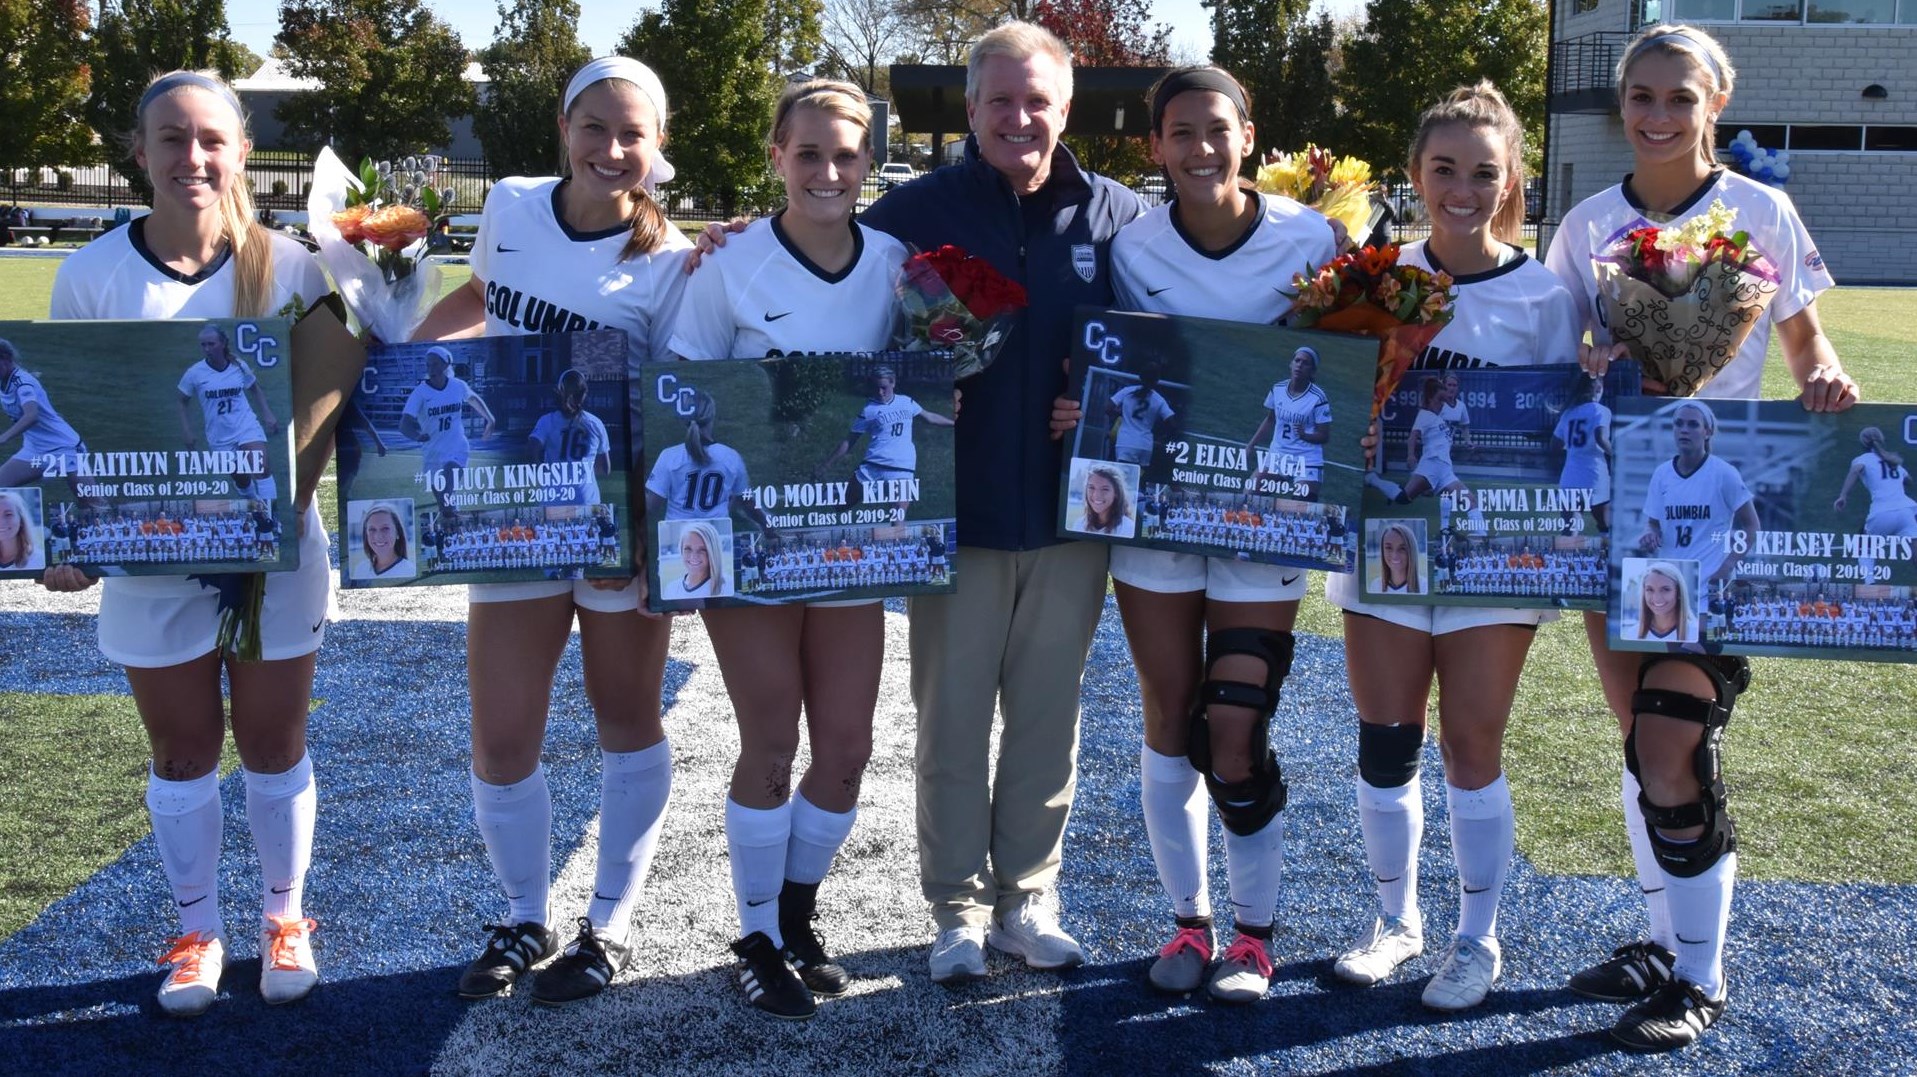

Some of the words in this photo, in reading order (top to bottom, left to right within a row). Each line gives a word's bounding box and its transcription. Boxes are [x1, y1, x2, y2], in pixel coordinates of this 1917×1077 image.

[486, 280, 617, 333] COLUMB
[217, 399, 232, 416] 21
[1132, 400, 1150, 420] 2
[1459, 391, 1497, 408] 1994
[439, 416, 452, 432] 16
[891, 422, 904, 437] 10
[1282, 424, 1292, 439] 2
[1568, 419, 1588, 449] 15
[560, 428, 590, 461] 16
[30, 454, 69, 478] #21
[77, 452, 168, 477] KAITLYN
[175, 450, 265, 475] TAMBKE
[1165, 440, 1190, 465] #2
[1195, 443, 1248, 471] ELISA
[1256, 452, 1307, 478] VEGA
[414, 469, 447, 493] #16
[452, 466, 497, 490] LUCY
[503, 461, 595, 488] KINGSLEY
[1172, 468, 1209, 486] Senior
[1213, 473, 1242, 490] Class
[1245, 476, 1257, 491] of
[1260, 478, 1310, 498] 2019-20
[77, 482, 119, 498] Senior
[123, 482, 155, 497] Class
[159, 481, 171, 496] of
[176, 481, 229, 496] 2019-20
[443, 492, 480, 507] Senior
[483, 491, 511, 505] Class
[514, 490, 525, 504] of
[528, 488, 576, 502] 2019-20
[682, 471, 725, 511] 10
[741, 486, 777, 509] #10
[784, 481, 848, 508] MOLLY
[862, 478, 920, 504] KLEIN
[1440, 489, 1471, 512] #15
[1477, 489, 1529, 512] EMMA
[1535, 488, 1594, 512] LANEY
[765, 512, 803, 529] Senior
[808, 511, 837, 526] Class
[841, 510, 853, 525] of
[856, 508, 905, 523] 2019-20
[1665, 505, 1711, 520] OLUMBIA
[1456, 517, 1491, 532] Senior
[1494, 517, 1520, 531] Class
[1523, 517, 1535, 531] of
[1537, 517, 1585, 532] 2019-20
[1675, 525, 1693, 548] 18
[1711, 530, 1748, 554] #18
[1755, 531, 1835, 559] KELSEY
[1842, 534, 1913, 561] MIRTS
[1736, 560, 1779, 576] Senior
[1782, 562, 1814, 578] Class
[1819, 563, 1833, 578] of
[1835, 565, 1891, 581] 2019-20
